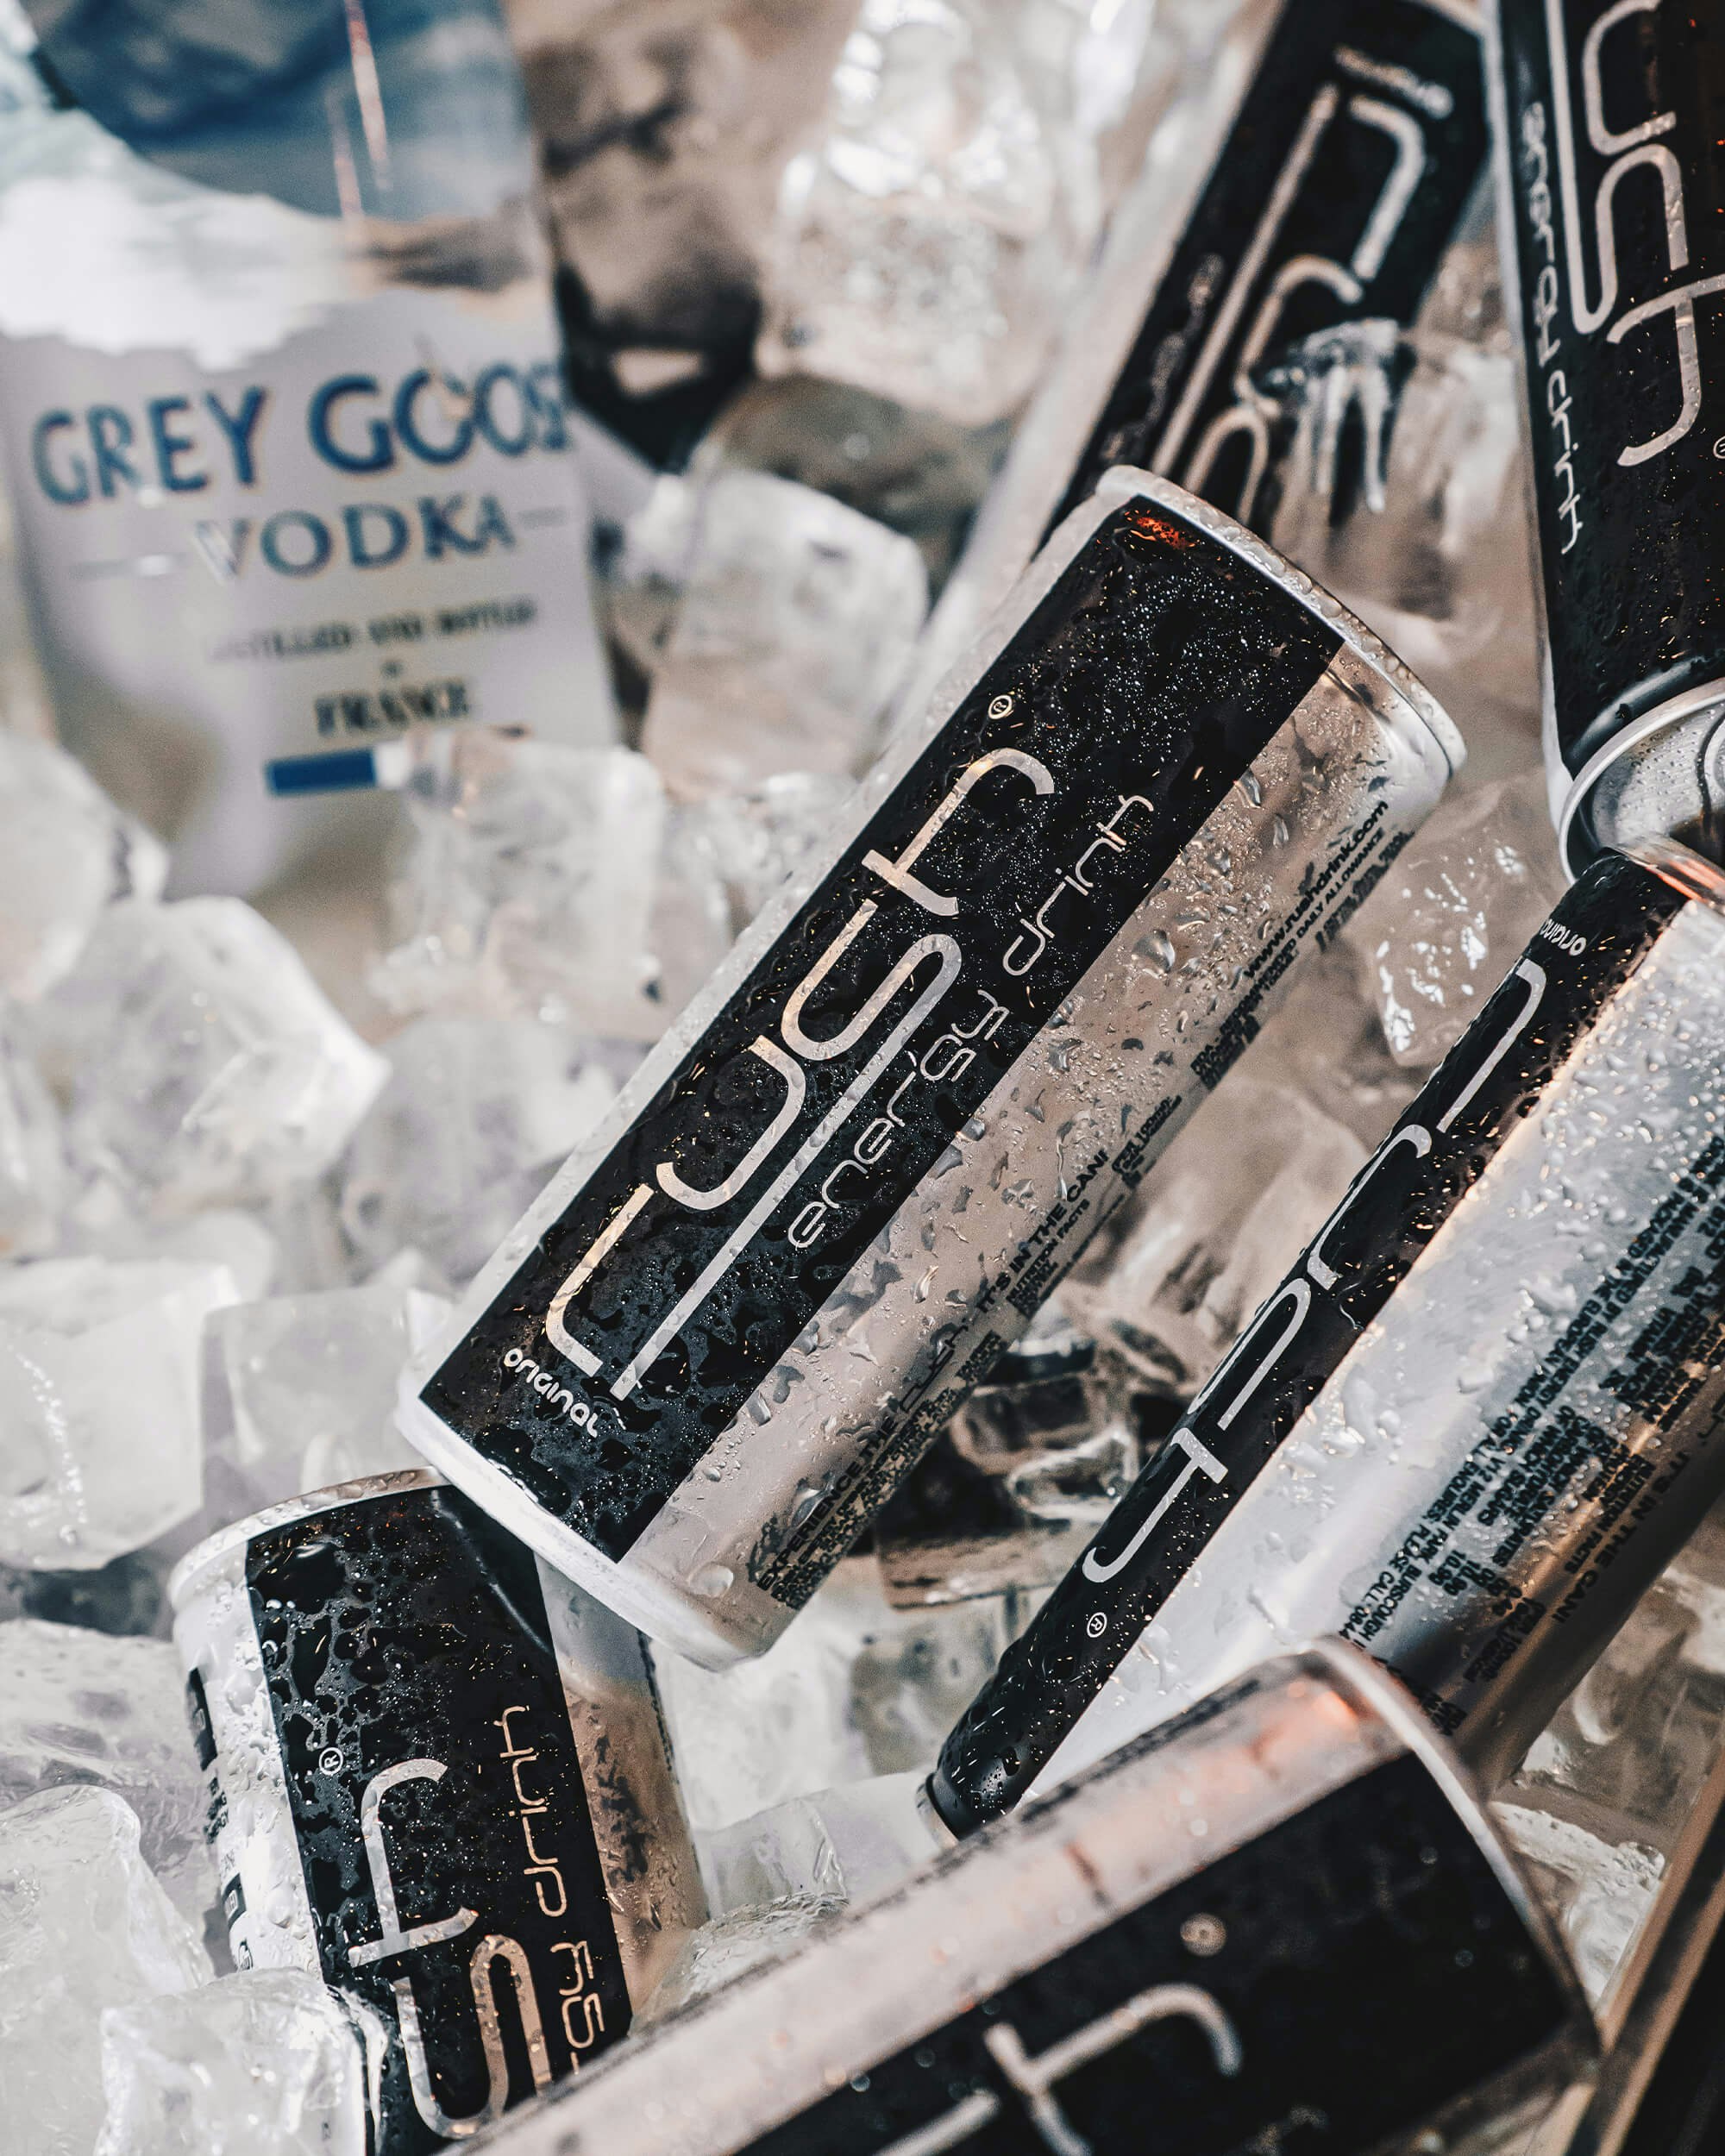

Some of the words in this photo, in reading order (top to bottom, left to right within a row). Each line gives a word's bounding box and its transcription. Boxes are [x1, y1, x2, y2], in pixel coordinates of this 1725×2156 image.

[31, 385, 269, 506] GREY
[306, 360, 573, 476] GOOS
[1546, 368, 1585, 555] drink
[194, 493, 518, 578] VODKA
[1240, 799, 1391, 981] www.rushdrink.com
[1295, 904, 1324, 937] DAILY
[1320, 826, 1386, 904] ALLOWANCE
[545, 747, 1055, 1401] rush
[787, 989, 1012, 1250] energy
[1002, 793, 1155, 976] drink
[1003, 1237, 1060, 1303] NUTRITION
[1055, 1197, 1091, 1239] FACTS
[1007, 1245, 1032, 1273] IN
[1026, 1201, 1068, 1249] THE
[1061, 1147, 1111, 1205] CAN!
[1598, 1300, 1623, 1325] BY
[1441, 1479, 1485, 1532] MERLIN
[1477, 1454, 1505, 1484] V12
[753, 1458, 866, 1592] EXPERIENCE
[1563, 1529, 1603, 1576] FACTS
[1594, 1520, 1636, 1570] THE
[1357, 1563, 1422, 1643] BURSCOUGH
[492, 1704, 569, 1918] drink
